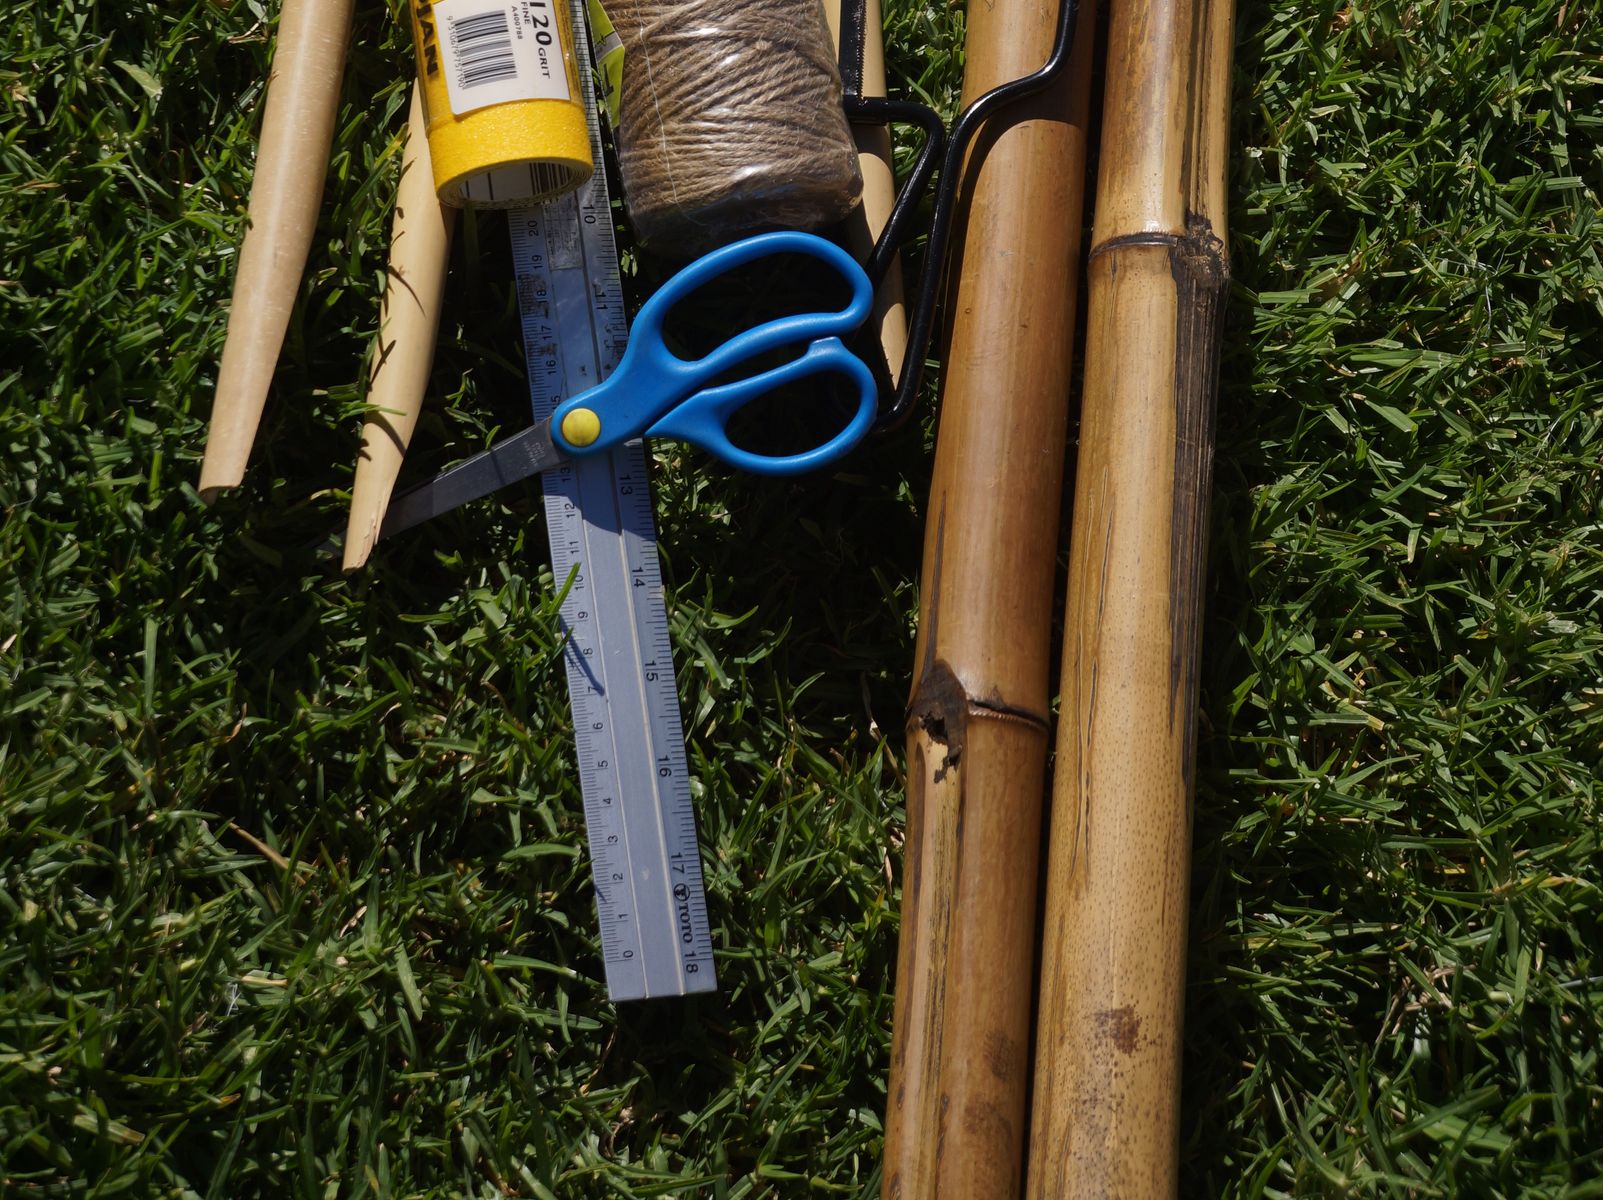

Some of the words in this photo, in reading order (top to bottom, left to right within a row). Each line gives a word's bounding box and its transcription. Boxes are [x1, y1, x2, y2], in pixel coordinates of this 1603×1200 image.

[521, 1, 531, 25] FINE
[529, 2, 552, 46] 120
[538, 47, 551, 79] GRIT
[528, 220, 539, 237] 20
[532, 255, 543, 269] 19
[541, 325, 552, 340] 17
[546, 359, 556, 374] 16
[564, 503, 575, 518] 12
[569, 540, 579, 554] 11
[574, 575, 584, 590] 10
[583, 205, 597, 224] 10
[596, 292, 608, 310] 11
[620, 474, 633, 494] 13
[632, 567, 645, 587] 14
[645, 660, 659, 681] 15
[658, 755, 672, 777] 16
[671, 852, 685, 874] 17
[684, 951, 699, 973] 18
